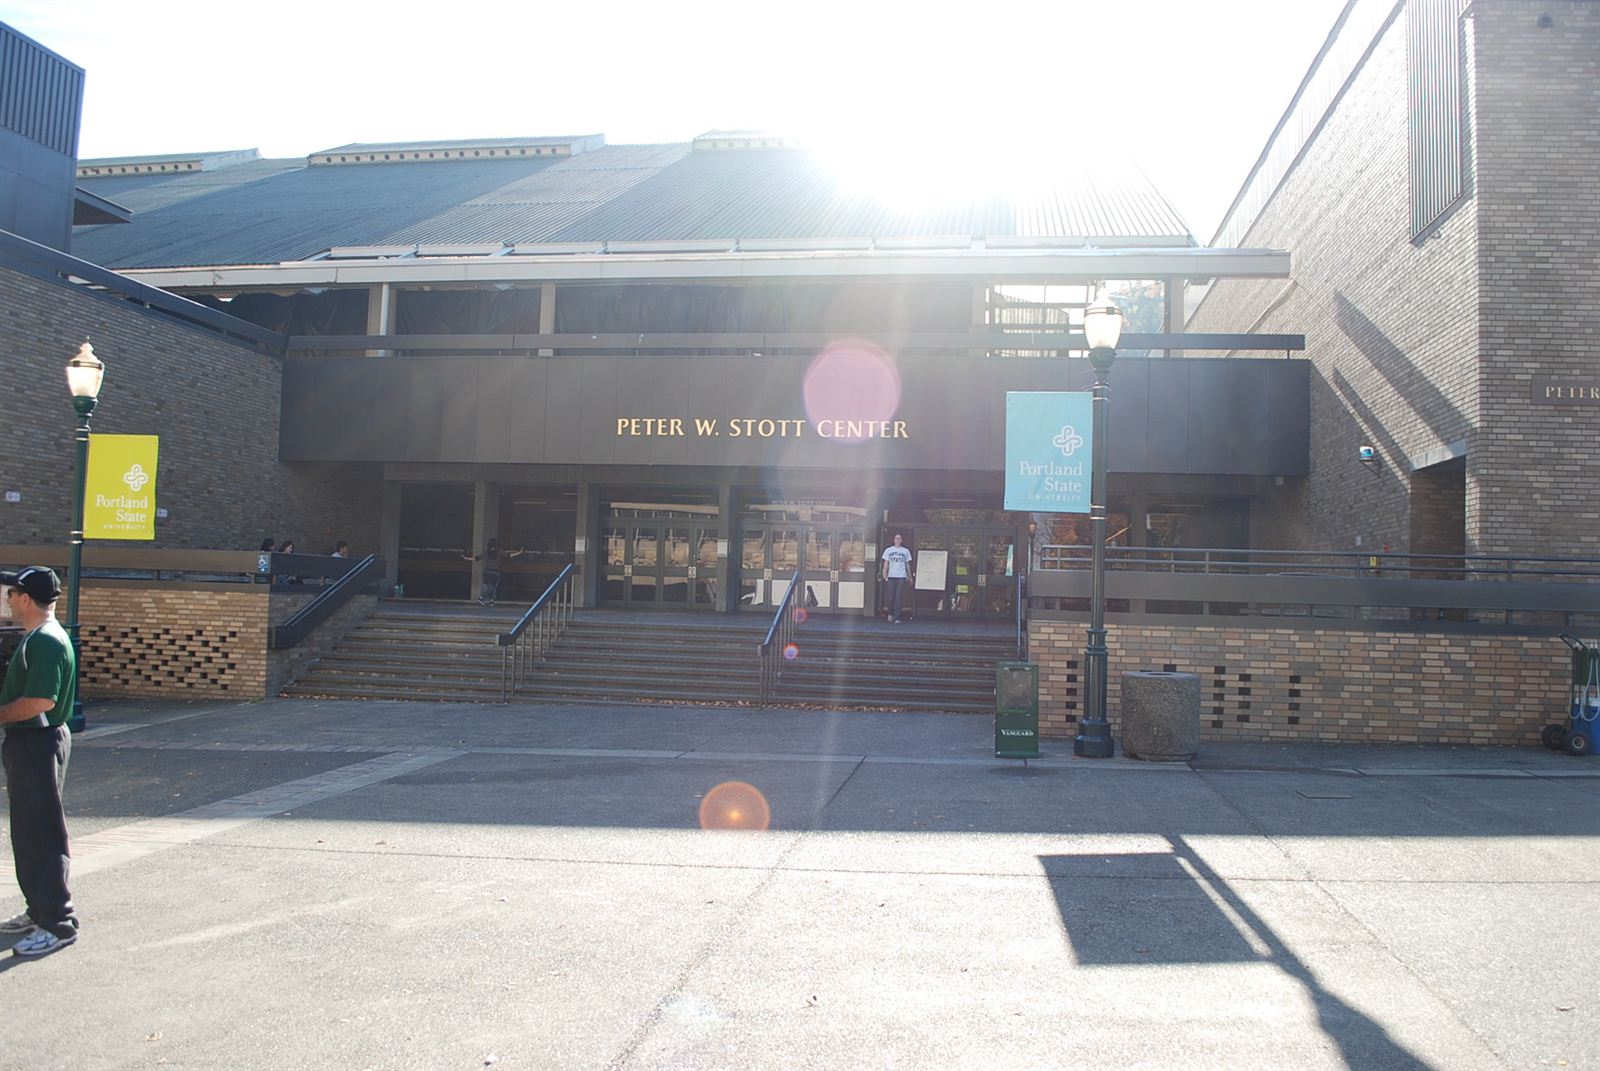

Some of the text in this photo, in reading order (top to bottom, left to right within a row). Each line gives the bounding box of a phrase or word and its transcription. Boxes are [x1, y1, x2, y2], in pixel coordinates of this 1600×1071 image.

[1545, 386, 1600, 399] PETER
[616, 418, 909, 438] PETER W. STOTT CENTER
[1019, 460, 1083, 477] Portland
[1044, 476, 1082, 493] State
[95, 494, 149, 509] Portland
[1028, 493, 1081, 501] UNIVERSITY
[115, 508, 147, 523] State
